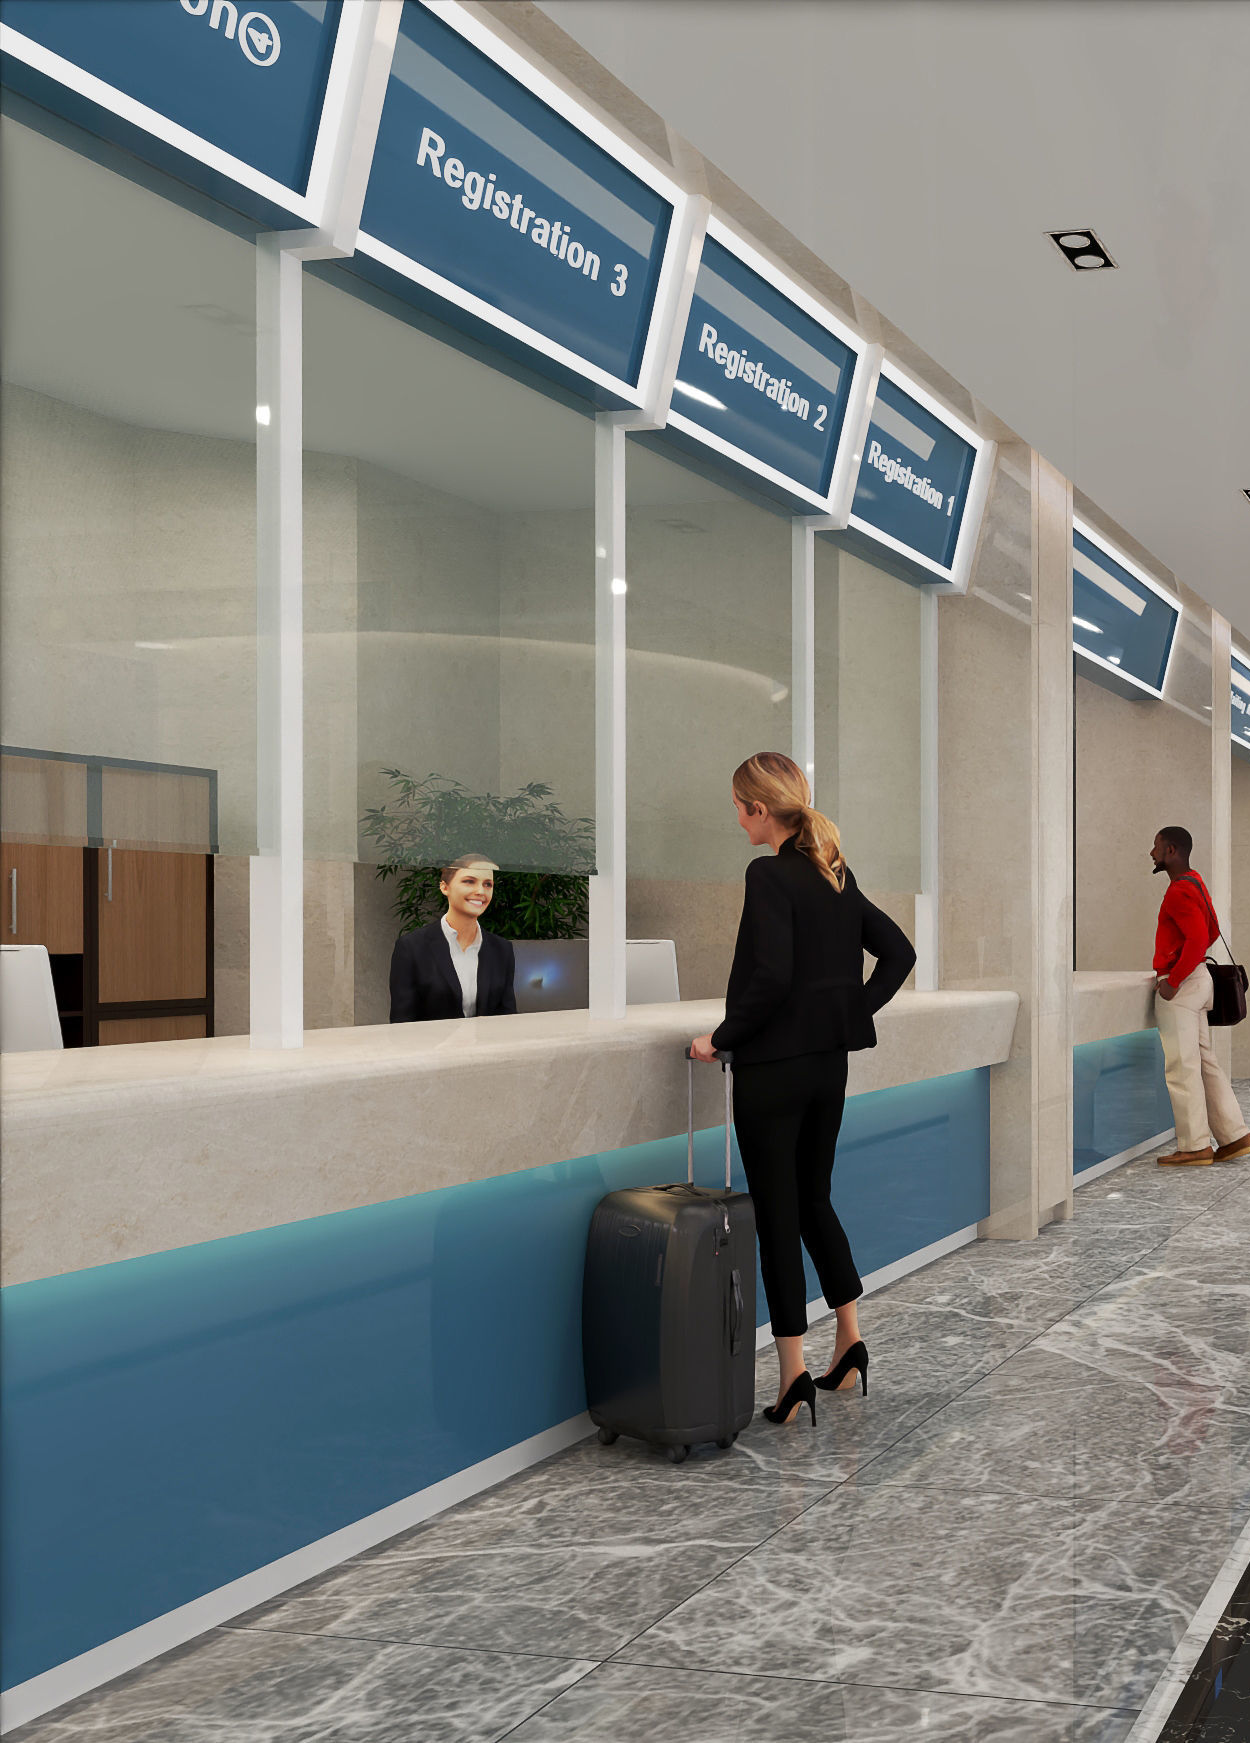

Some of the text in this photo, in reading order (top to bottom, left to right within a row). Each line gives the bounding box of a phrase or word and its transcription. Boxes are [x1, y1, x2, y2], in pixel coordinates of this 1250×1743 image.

[416, 127, 628, 297] Registration 3
[698, 323, 828, 432] Registration 2
[867, 440, 955, 517] Registration 1
